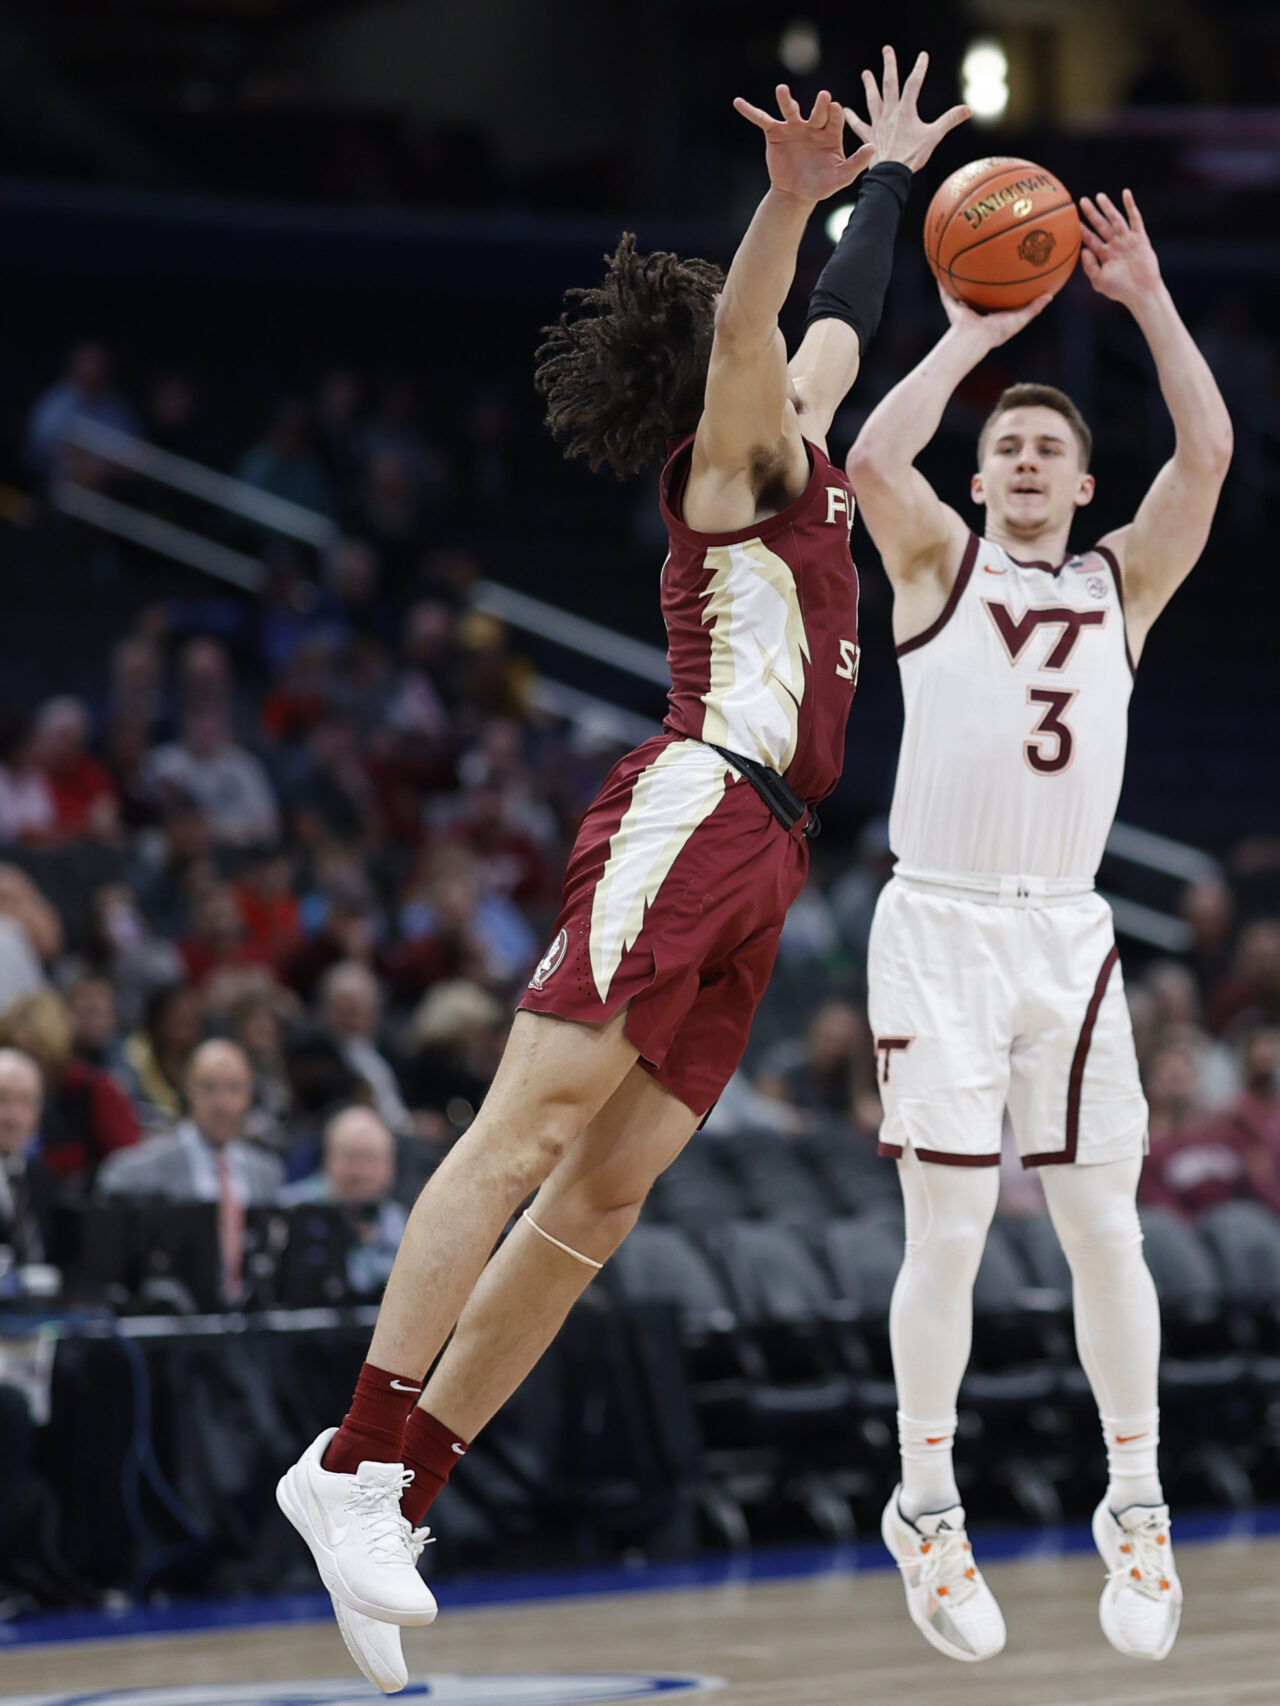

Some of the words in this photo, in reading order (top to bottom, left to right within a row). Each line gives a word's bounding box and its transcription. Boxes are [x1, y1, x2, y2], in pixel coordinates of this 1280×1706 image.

[963, 174, 1057, 230] SPALDING
[981, 598, 1109, 674] VT
[1023, 685, 1080, 777] 3
